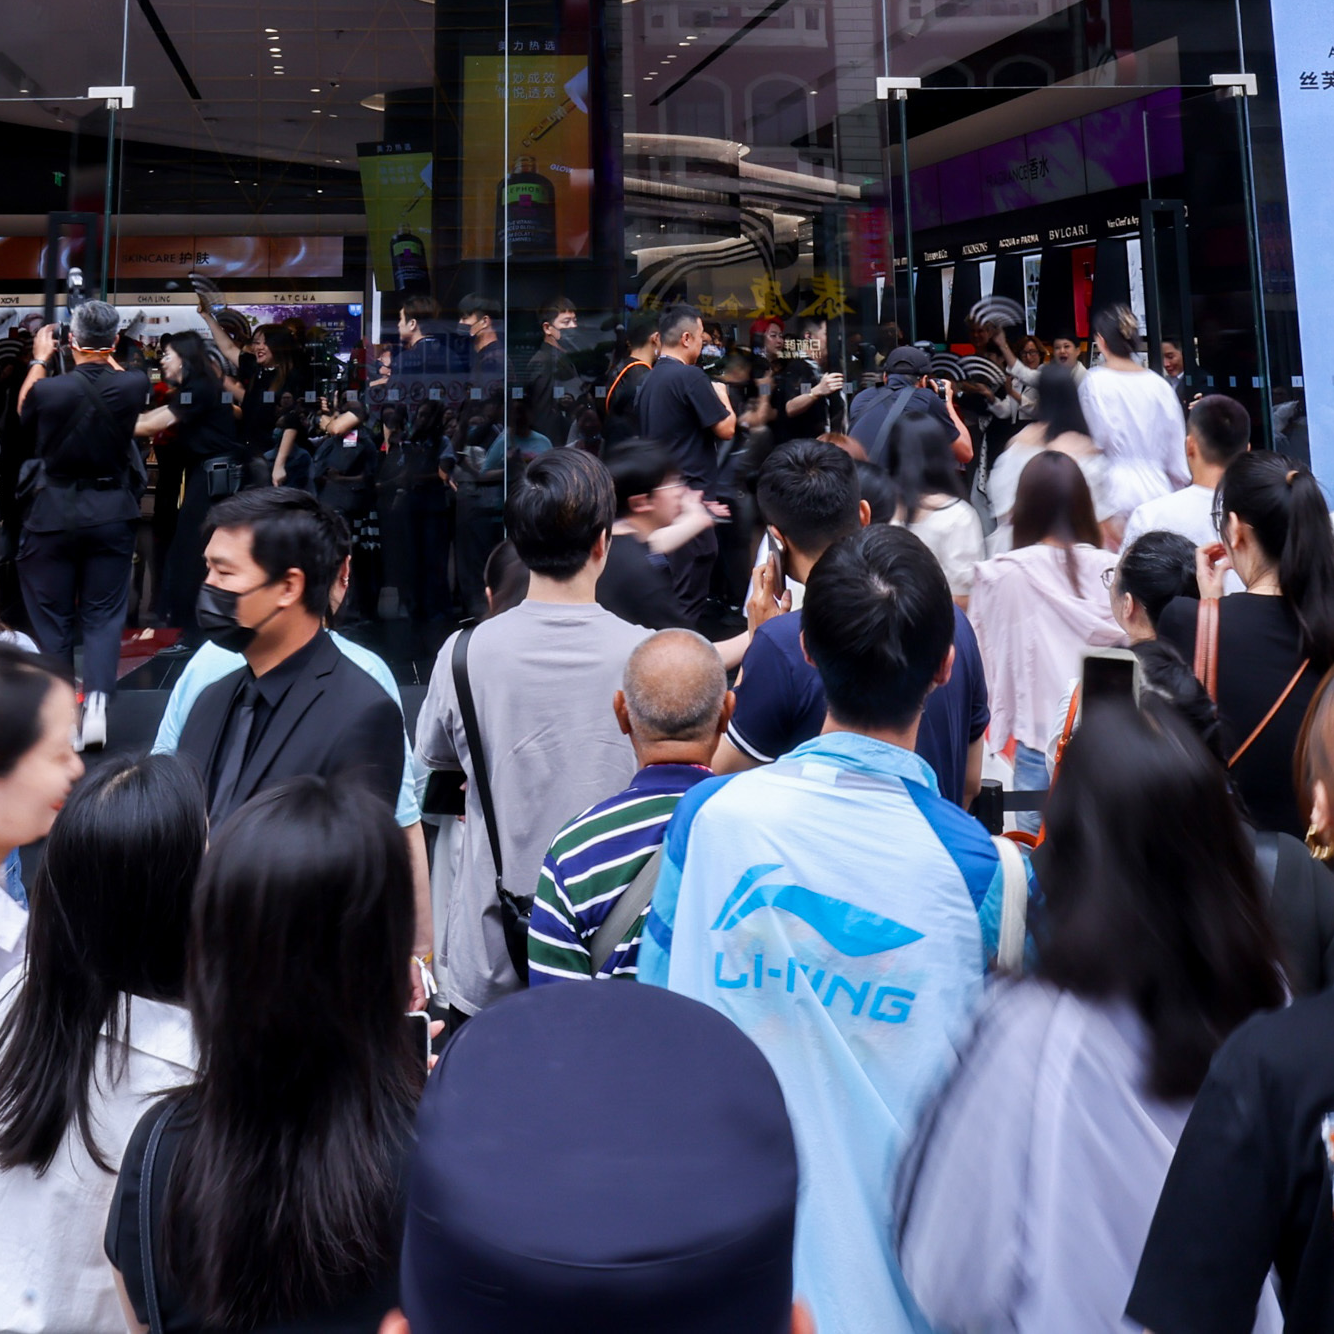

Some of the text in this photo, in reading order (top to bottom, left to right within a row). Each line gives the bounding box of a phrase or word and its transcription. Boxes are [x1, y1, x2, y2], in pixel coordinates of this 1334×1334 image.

[1029, 155, 1050, 181] 香水
[1049, 223, 1089, 241] BVLGARI
[179, 252, 210, 264] 护肤
[274, 294, 316, 303] TATCHA
